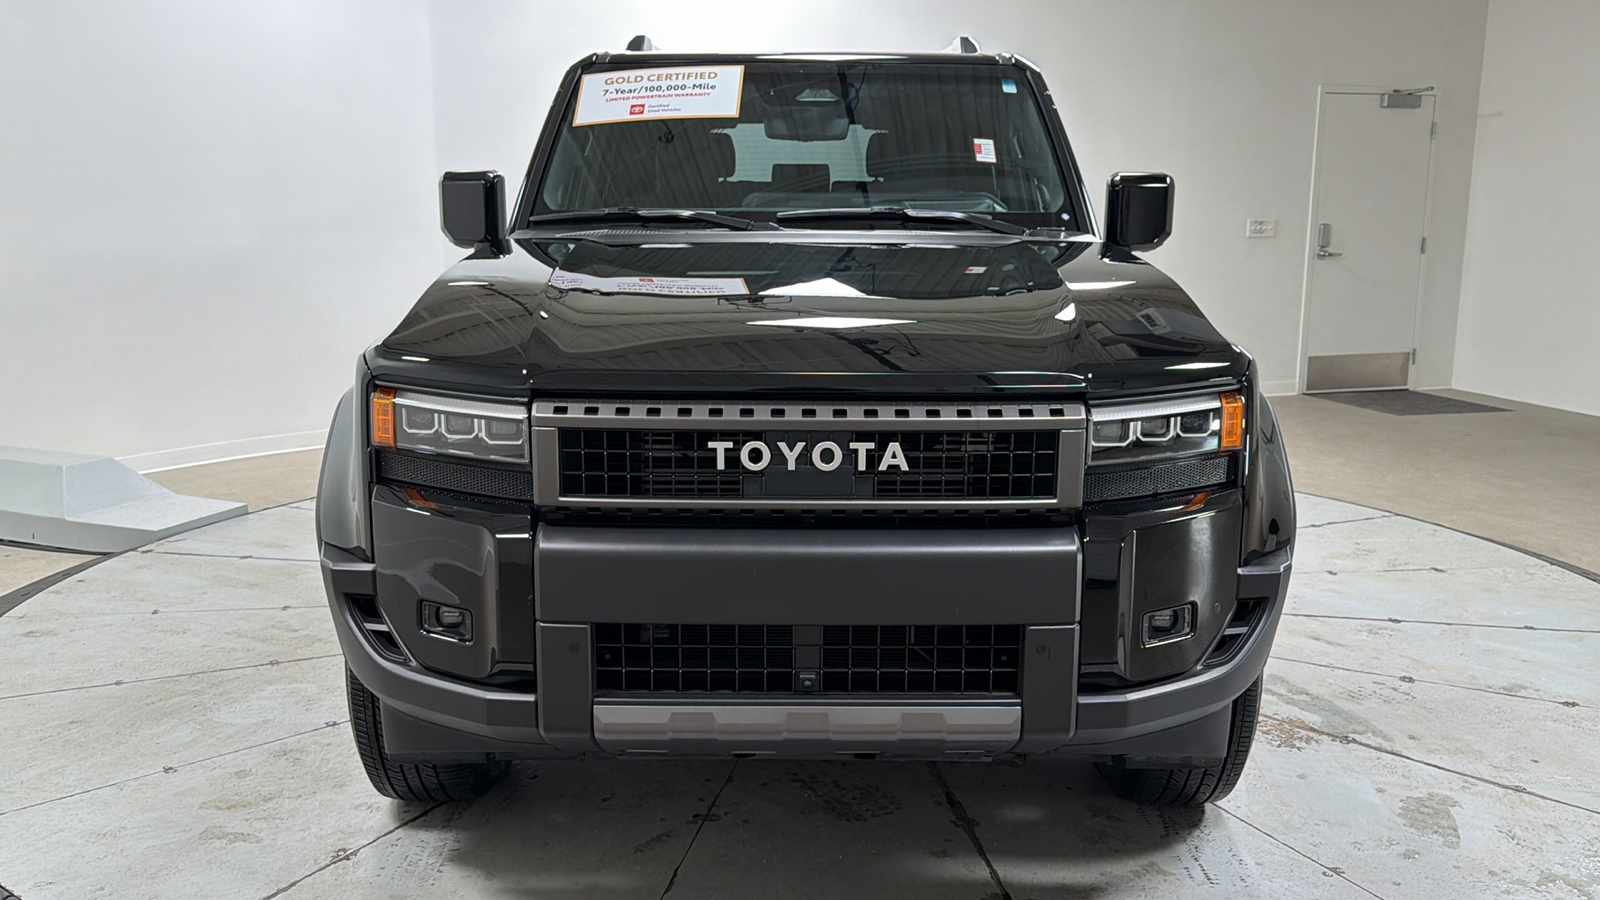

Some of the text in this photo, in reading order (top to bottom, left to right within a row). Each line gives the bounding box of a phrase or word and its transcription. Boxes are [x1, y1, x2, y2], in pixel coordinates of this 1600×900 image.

[604, 71, 718, 86] GOLD CERTIFIED
[602, 83, 717, 96] 7-Year/100,000-Mile
[631, 93, 673, 101] POWERTRAIN
[707, 441, 910, 471] TOYOTA
